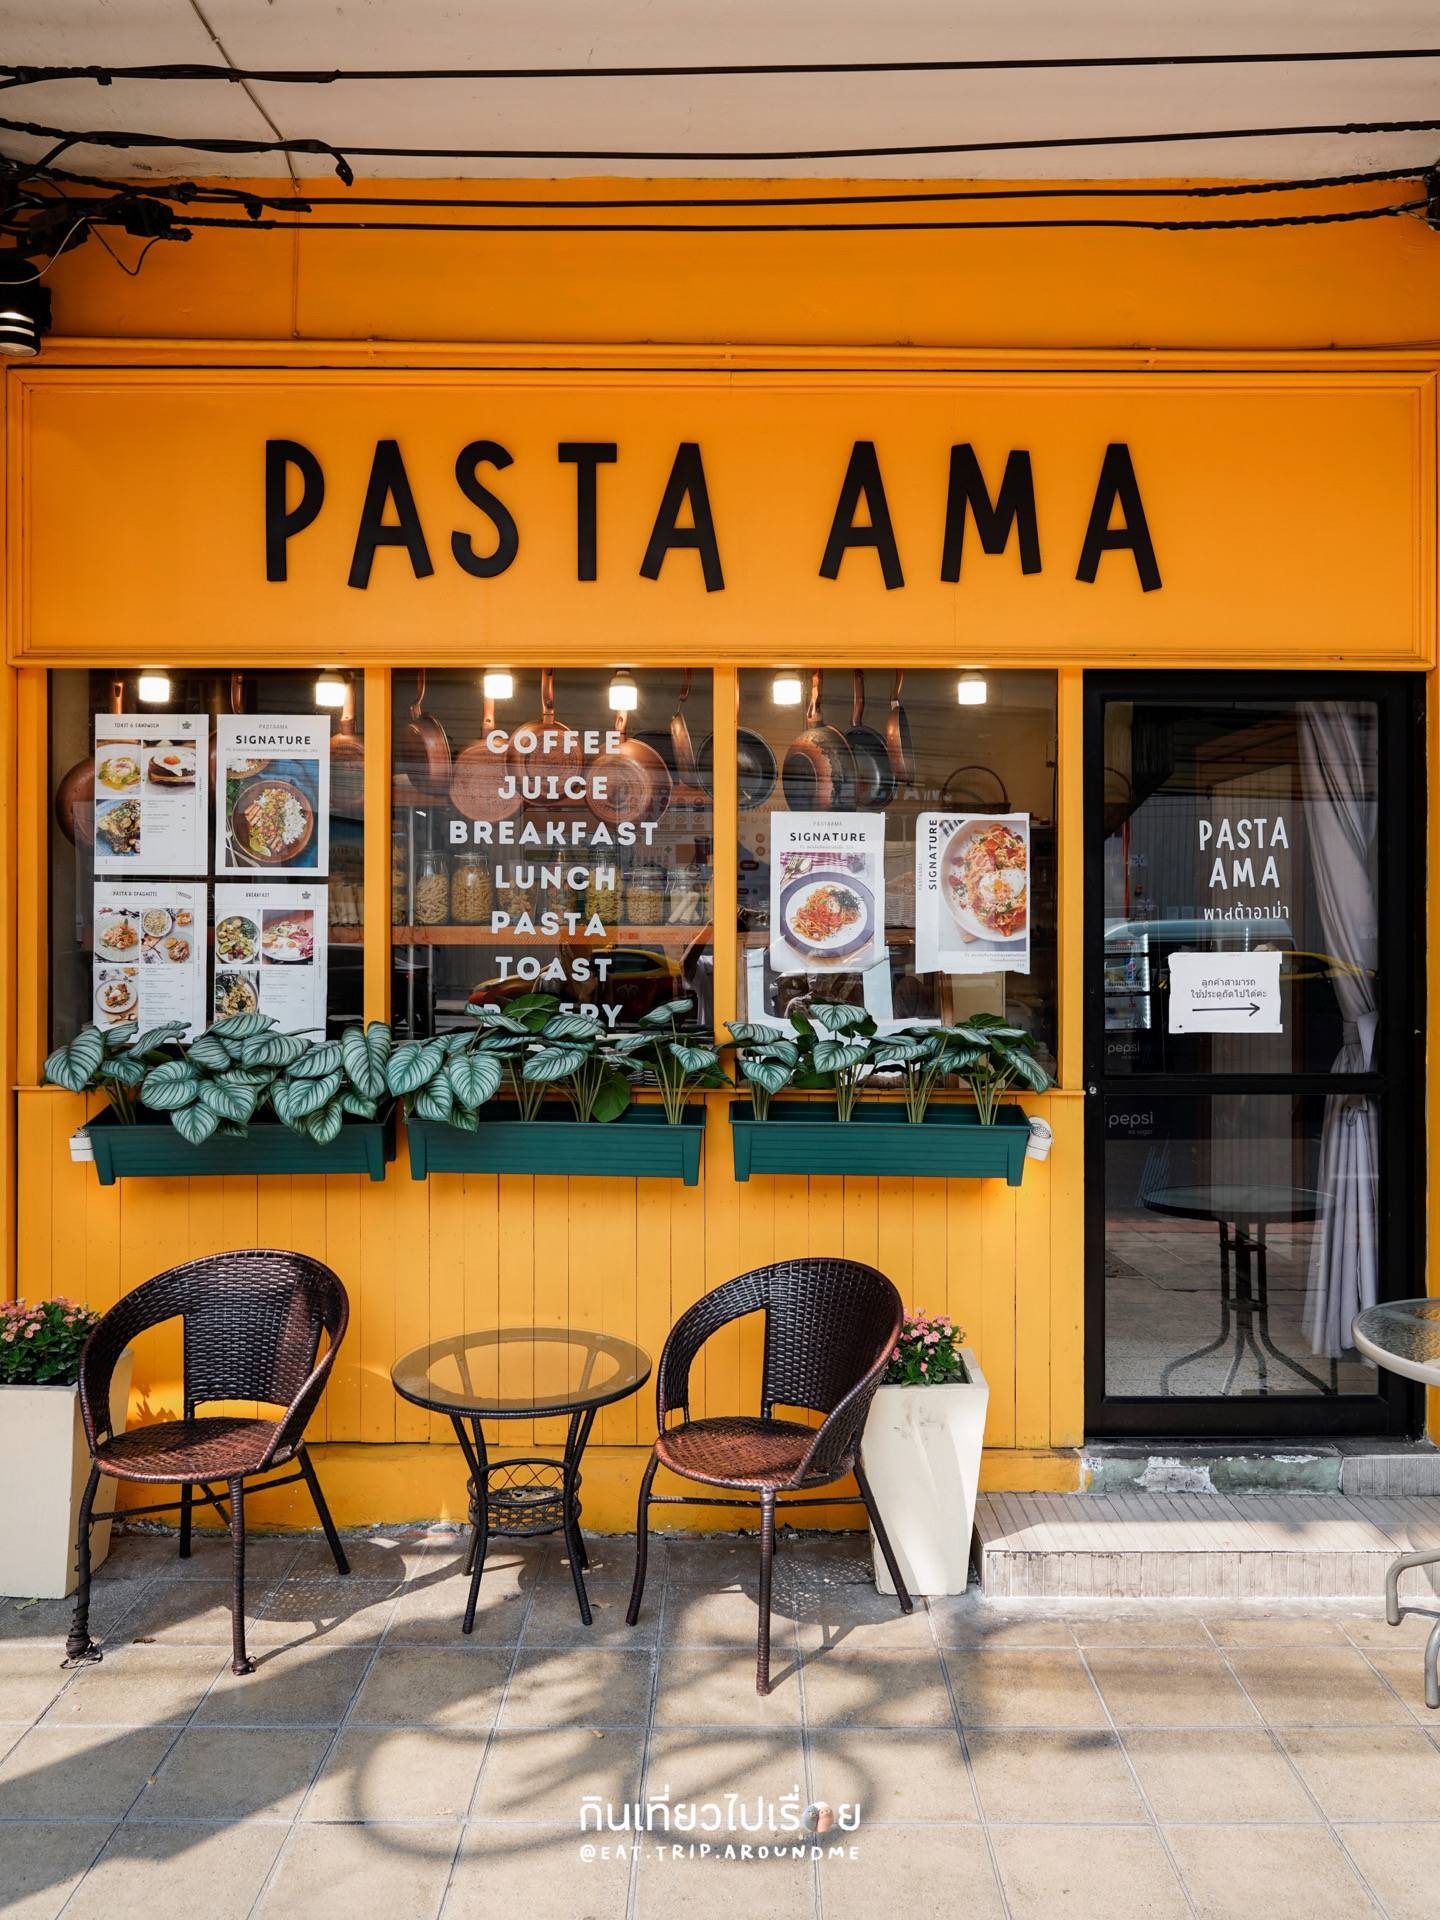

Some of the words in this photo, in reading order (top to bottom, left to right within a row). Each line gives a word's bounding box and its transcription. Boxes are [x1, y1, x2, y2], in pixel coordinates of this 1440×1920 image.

[265, 440, 726, 592] PASTA
[818, 440, 1163, 592] AMA
[235, 735, 311, 745] SIGNATURE
[486, 729, 621, 754] COFFEE
[498, 775, 608, 800] JUICE
[449, 820, 658, 846] BREAKFAST
[789, 832, 866, 842] SIGNATURE
[1199, 816, 1290, 851] PASTA
[928, 819, 938, 891] SIGNATURE
[495, 865, 616, 891] LUNCH
[1208, 855, 1281, 890] AMA
[491, 910, 607, 937] PASTA
[1203, 900, 1289, 921] พาสต้าอาม่า
[495, 956, 612, 982] TOAST
[1107, 1040, 1140, 1056] pepsi
[1109, 1111, 1153, 1128] pepsi
